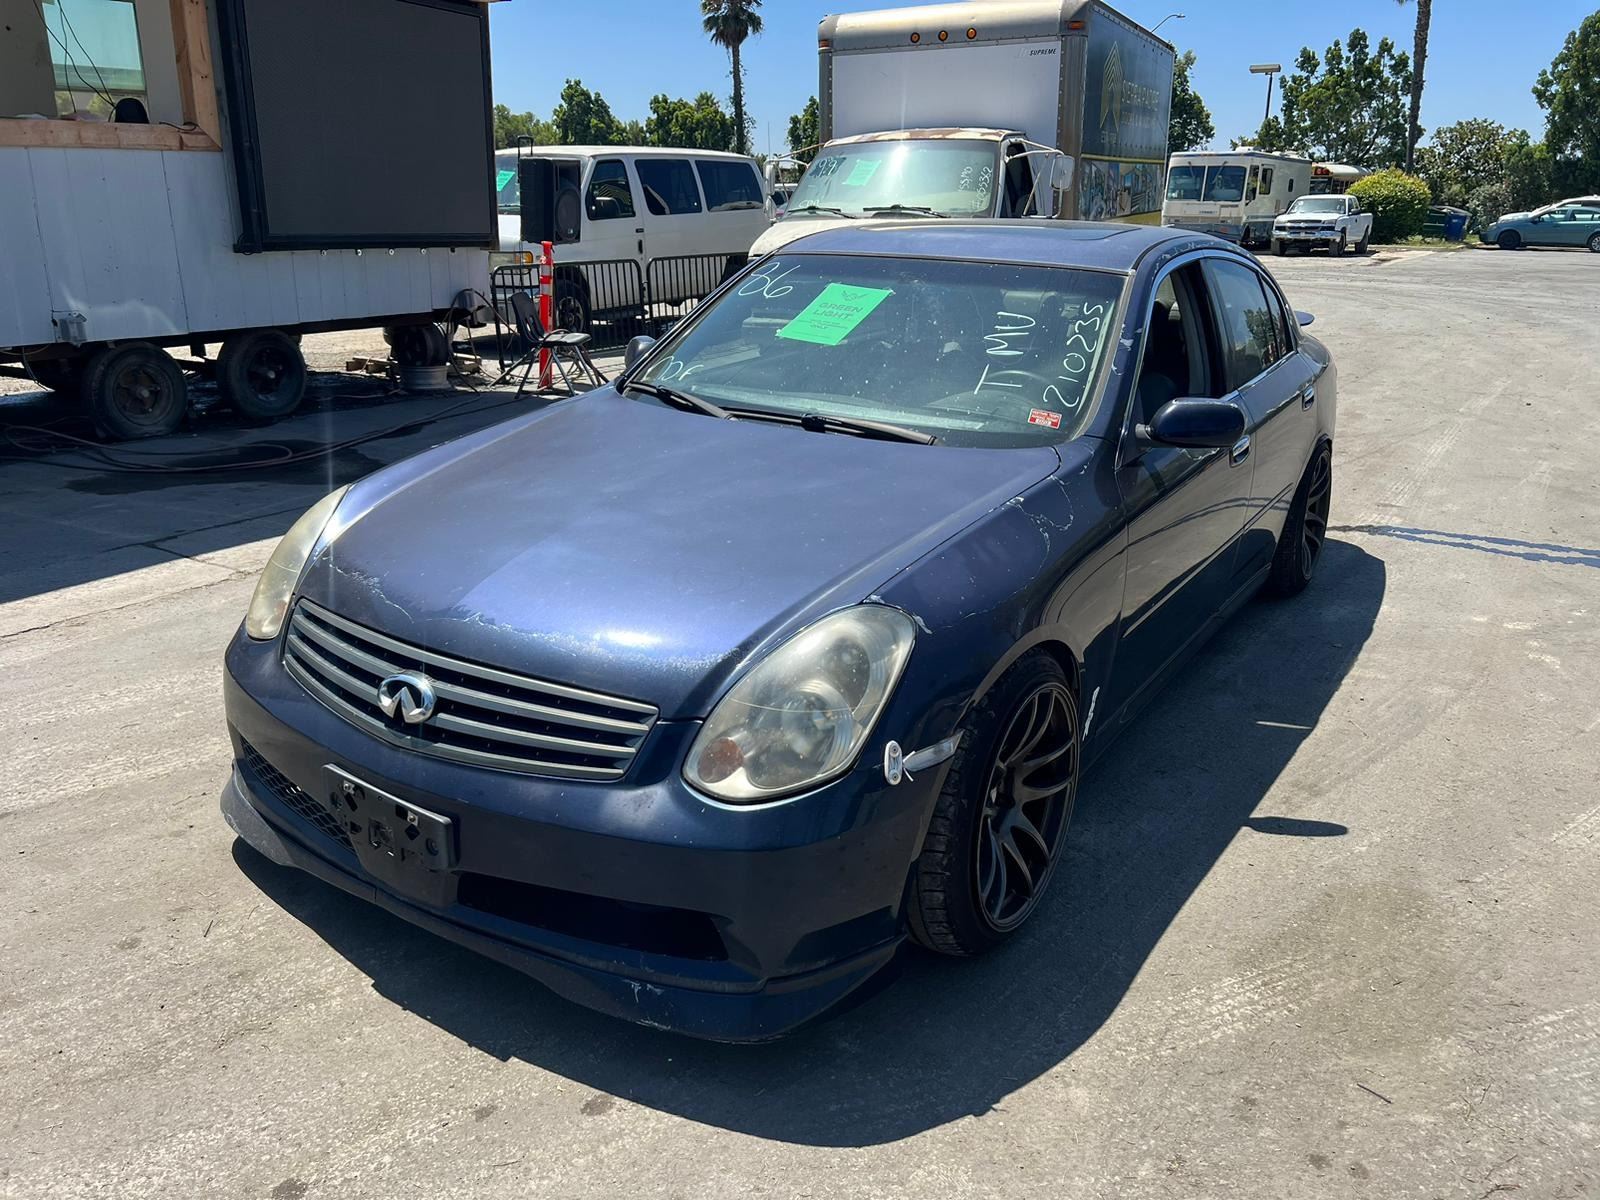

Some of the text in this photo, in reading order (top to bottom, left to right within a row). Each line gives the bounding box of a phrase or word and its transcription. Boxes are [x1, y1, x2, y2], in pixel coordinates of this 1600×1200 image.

[1029, 48, 1057, 56] SUPREME
[819, 302, 864, 313] GREEN
[813, 309, 855, 320] LIGHT
[1043, 302, 1104, 408] 210235
